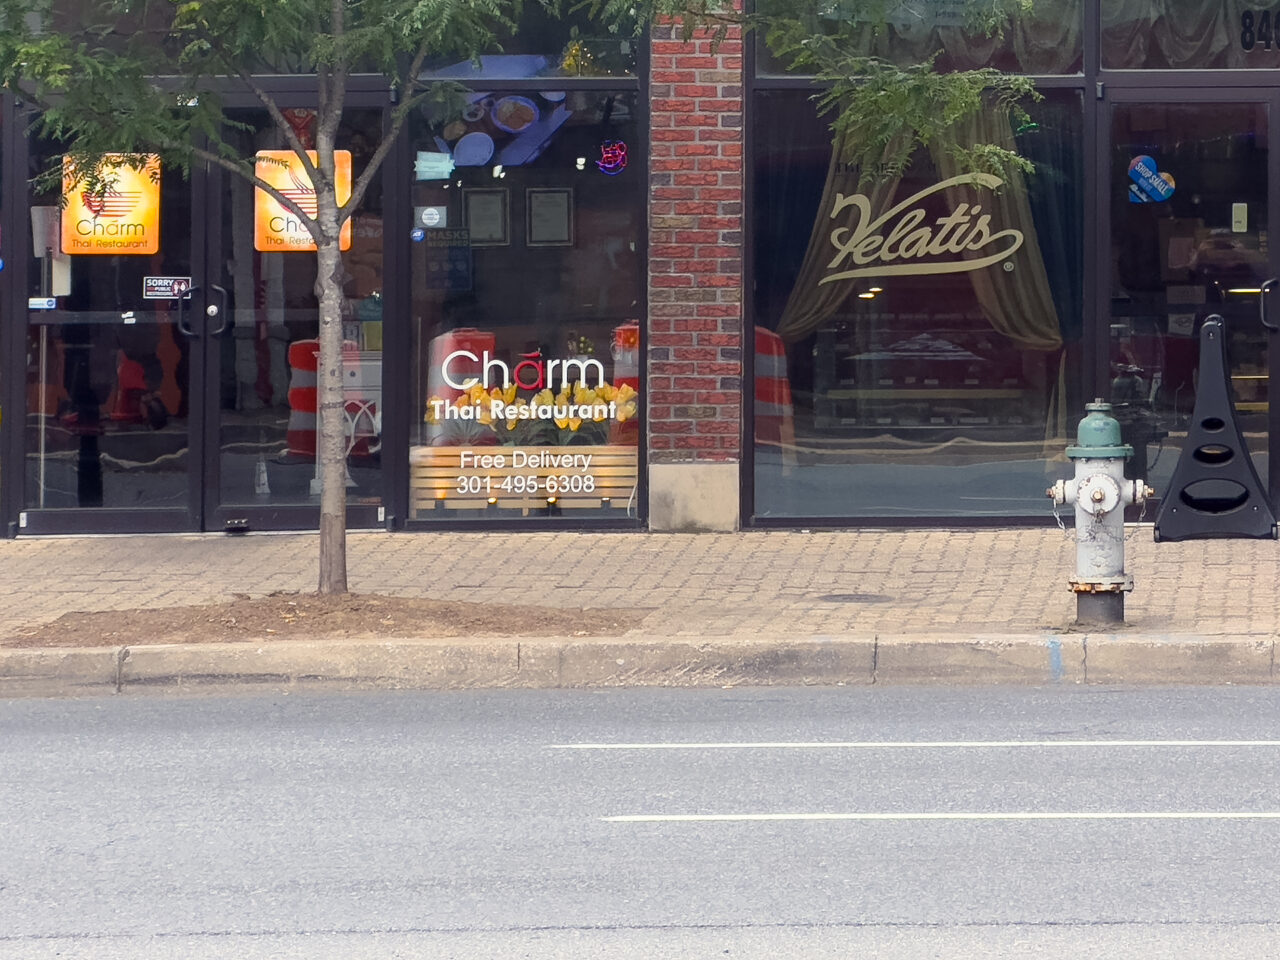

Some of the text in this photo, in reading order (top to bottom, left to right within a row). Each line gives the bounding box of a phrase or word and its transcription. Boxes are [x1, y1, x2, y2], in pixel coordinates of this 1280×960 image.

[1135, 162, 1153, 179] SHOP
[818, 172, 1024, 287] Velatis
[72, 239, 148, 248] Thai Restaurant
[289, 237, 315, 245] Resta
[431, 399, 616, 420] Thai Restaurant
[460, 450, 593, 472] Free Delivery
[456, 475, 595, 494] 301-495-6308
